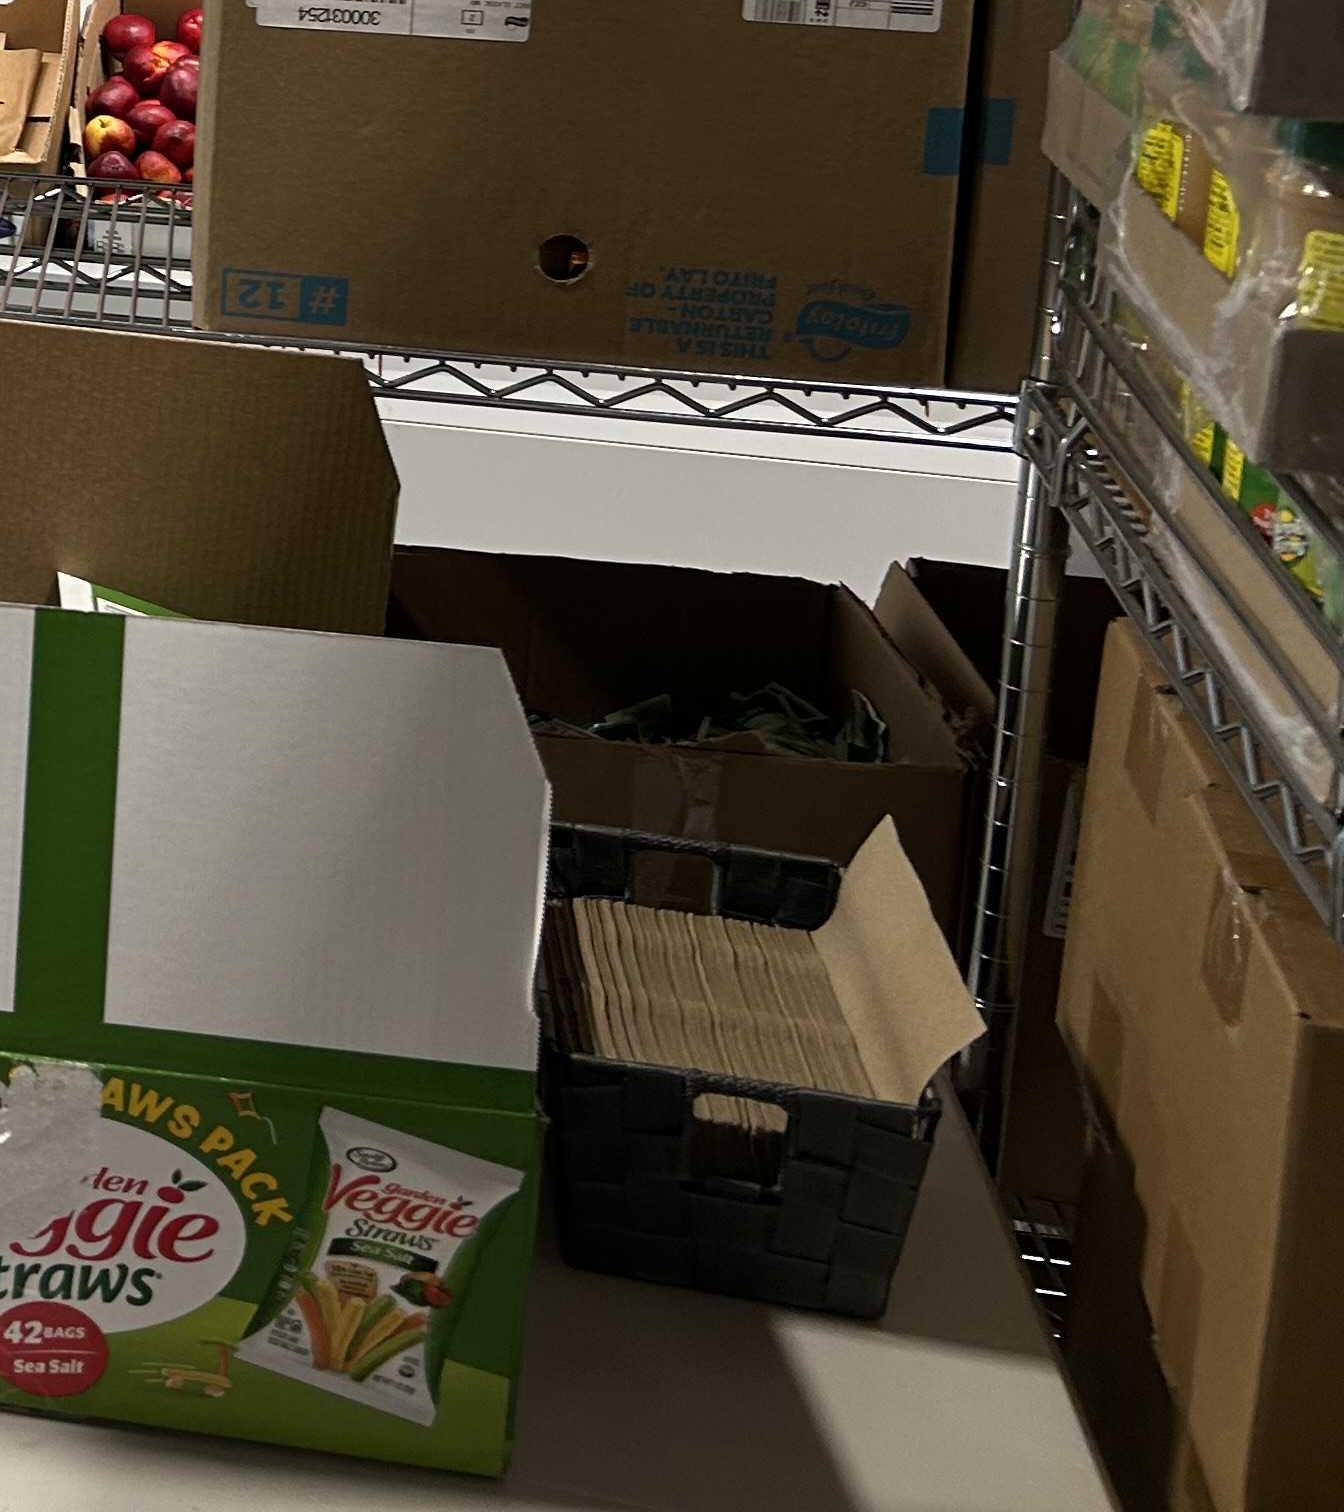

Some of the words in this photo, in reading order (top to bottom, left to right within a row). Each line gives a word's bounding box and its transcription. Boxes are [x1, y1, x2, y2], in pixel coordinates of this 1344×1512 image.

[298, 7, 382, 26] 300031254
[238, 279, 286, 311] 12
[625, 283, 658, 299] OF
[658, 285, 778, 309] PROPERTY
[680, 304, 776, 326] CARTON
[628, 317, 775, 342] RETURNABLE
[720, 342, 772, 361] THIS
[198, 1125, 294, 1228] PACK
[323, 1163, 481, 1239] Veggie
[345, 1217, 439, 1251] Straws
[348, 1240, 382, 1258] Sea
[3, 1320, 44, 1344] 42
[43, 1325, 86, 1340] BAGS
[13, 1358, 47, 1375] Sea
[48, 1358, 85, 1375] Salt
